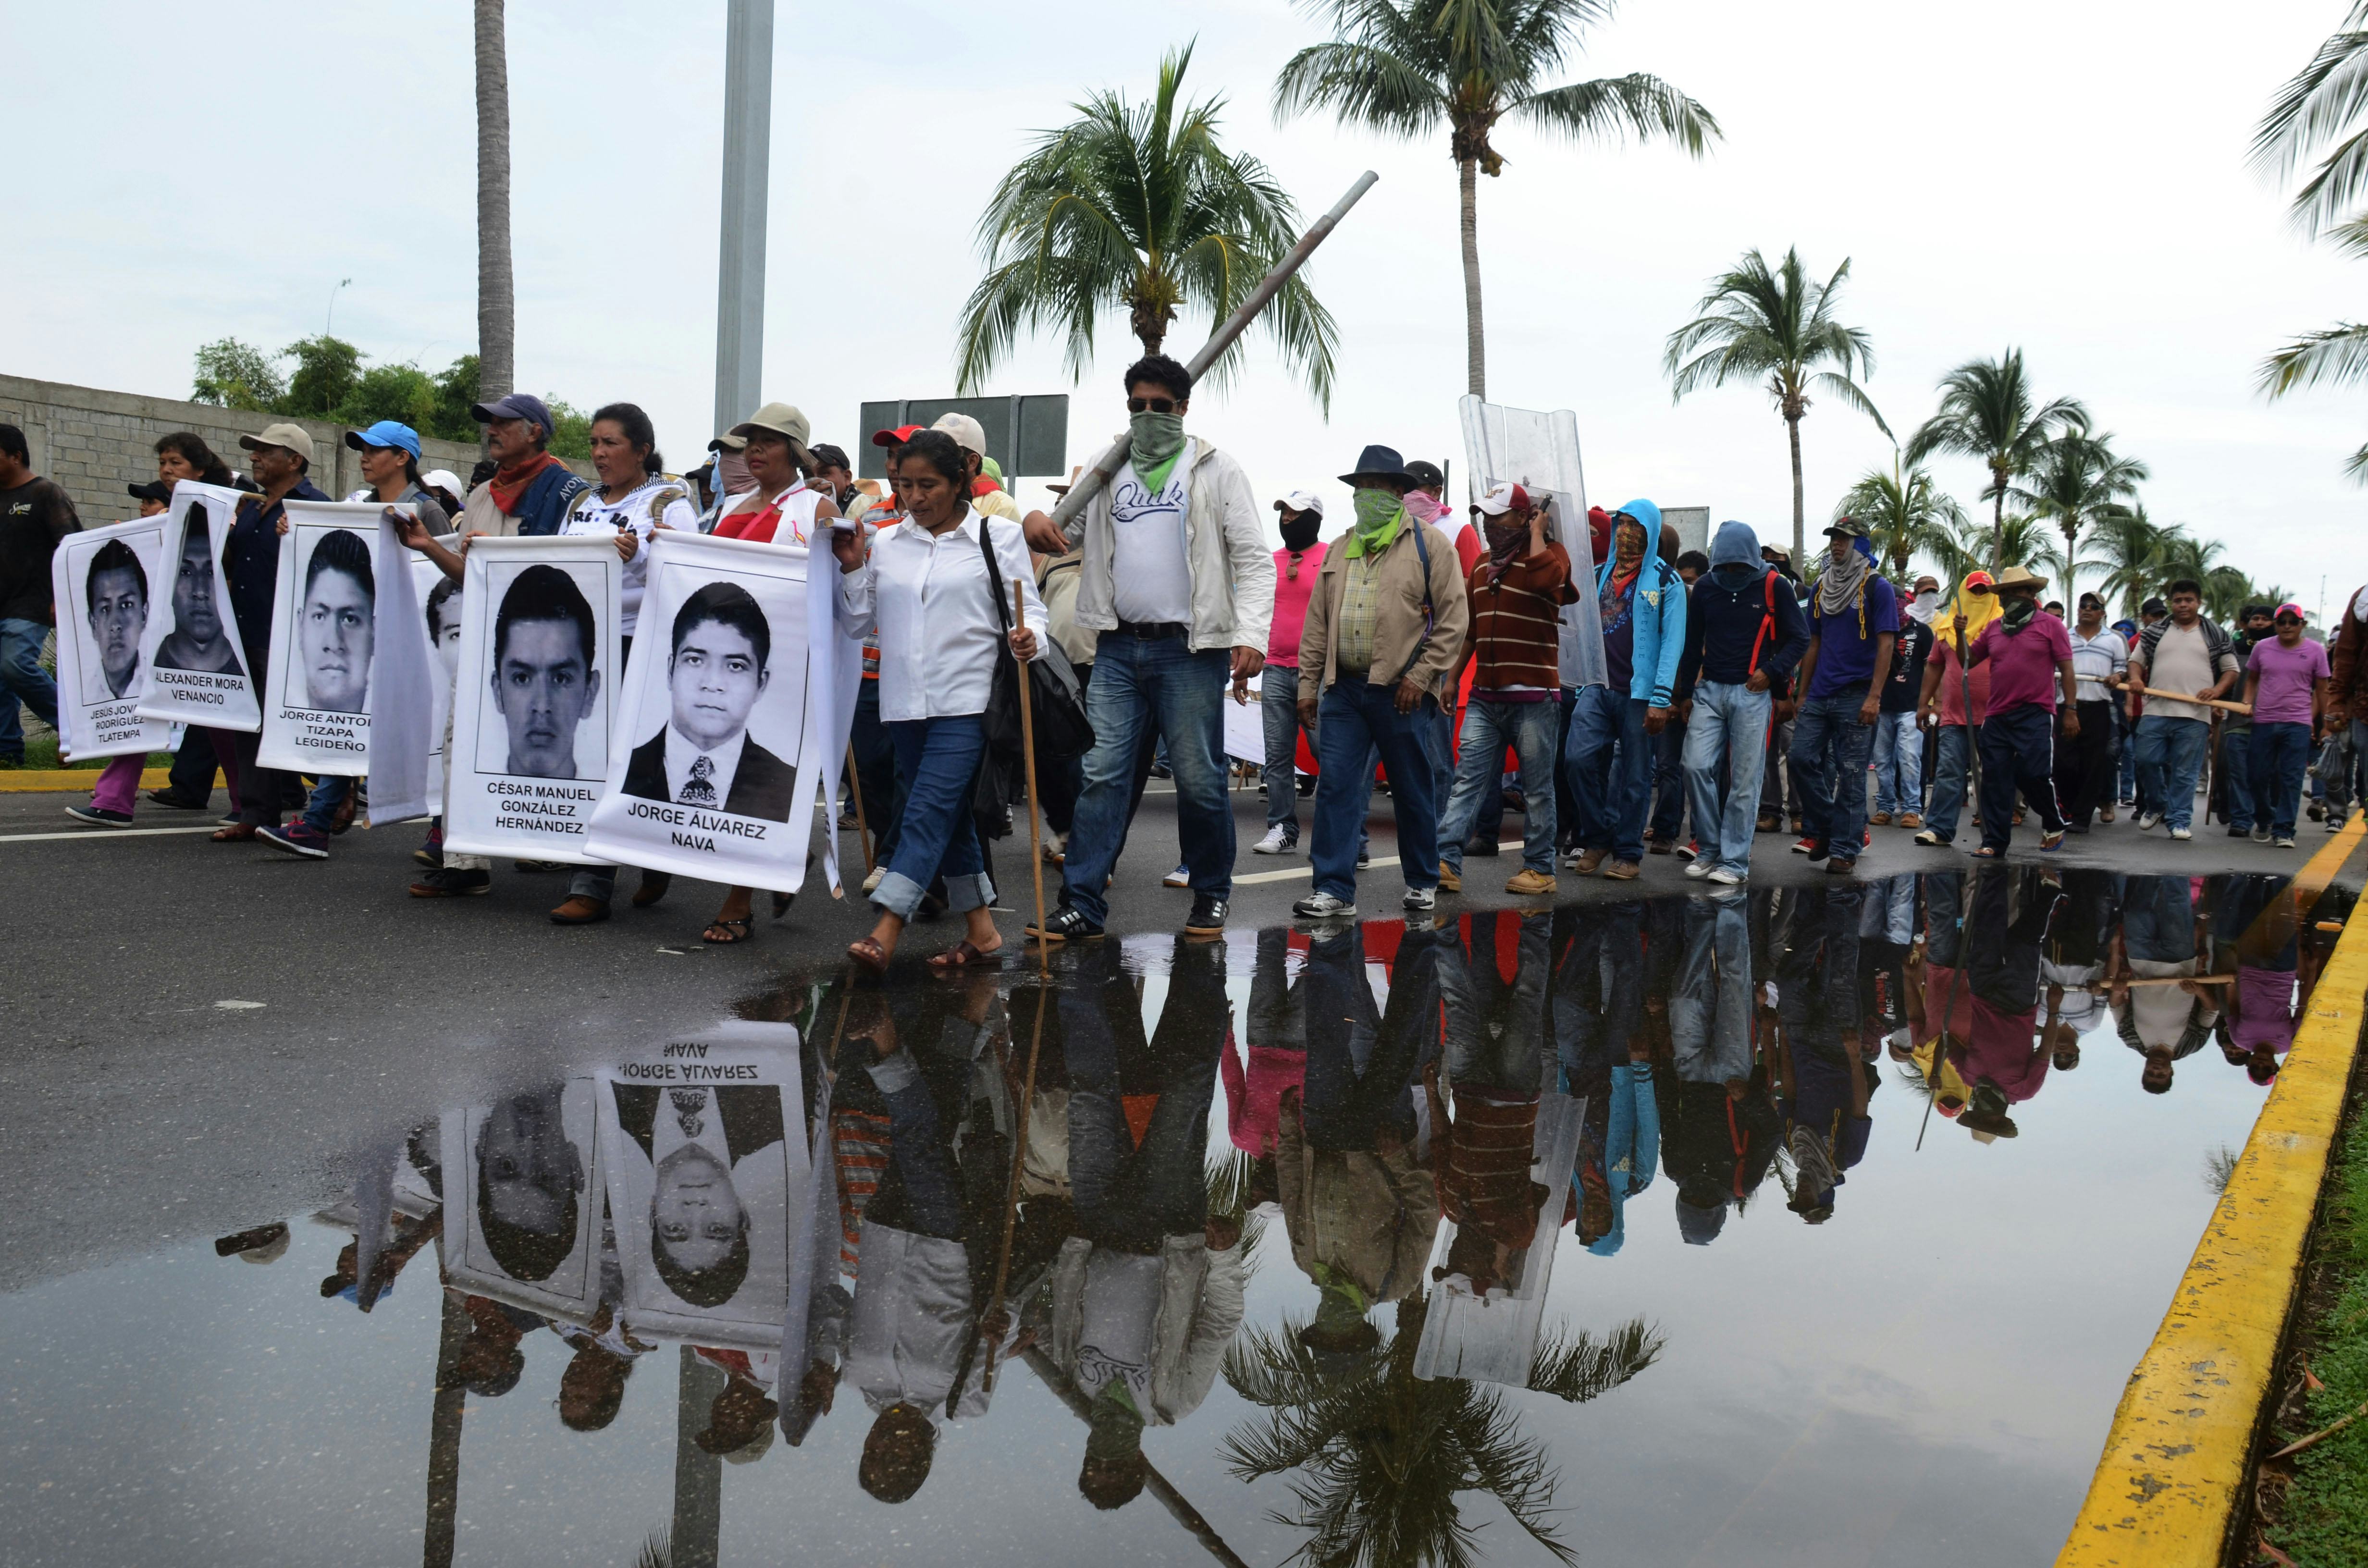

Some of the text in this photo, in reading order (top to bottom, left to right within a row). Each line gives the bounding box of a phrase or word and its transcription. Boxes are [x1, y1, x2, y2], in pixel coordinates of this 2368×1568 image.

[1639, 611, 1650, 658] LEAGUE
[1905, 641, 1915, 656] NYC
[155, 672, 244, 691] ALEXANDER MORA
[171, 689, 224, 705] VENANCIO
[90, 707, 113, 720] JESÚS
[280, 710, 323, 722] JORGE
[96, 716, 144, 731] RODRÍGUEZ
[306, 725, 354, 738] TIZAPA
[99, 729, 141, 743] TLATEMPA
[295, 736, 366, 752] LEGIDEÑO
[487, 781, 596, 801] CÉSAR MANUEL
[501, 800, 576, 817] GONZÁLEZ
[495, 816, 584, 834] HERNÁNDEZ
[628, 803, 766, 840] JORGE ÁLVAREZ
[671, 832, 715, 852] NAVA
